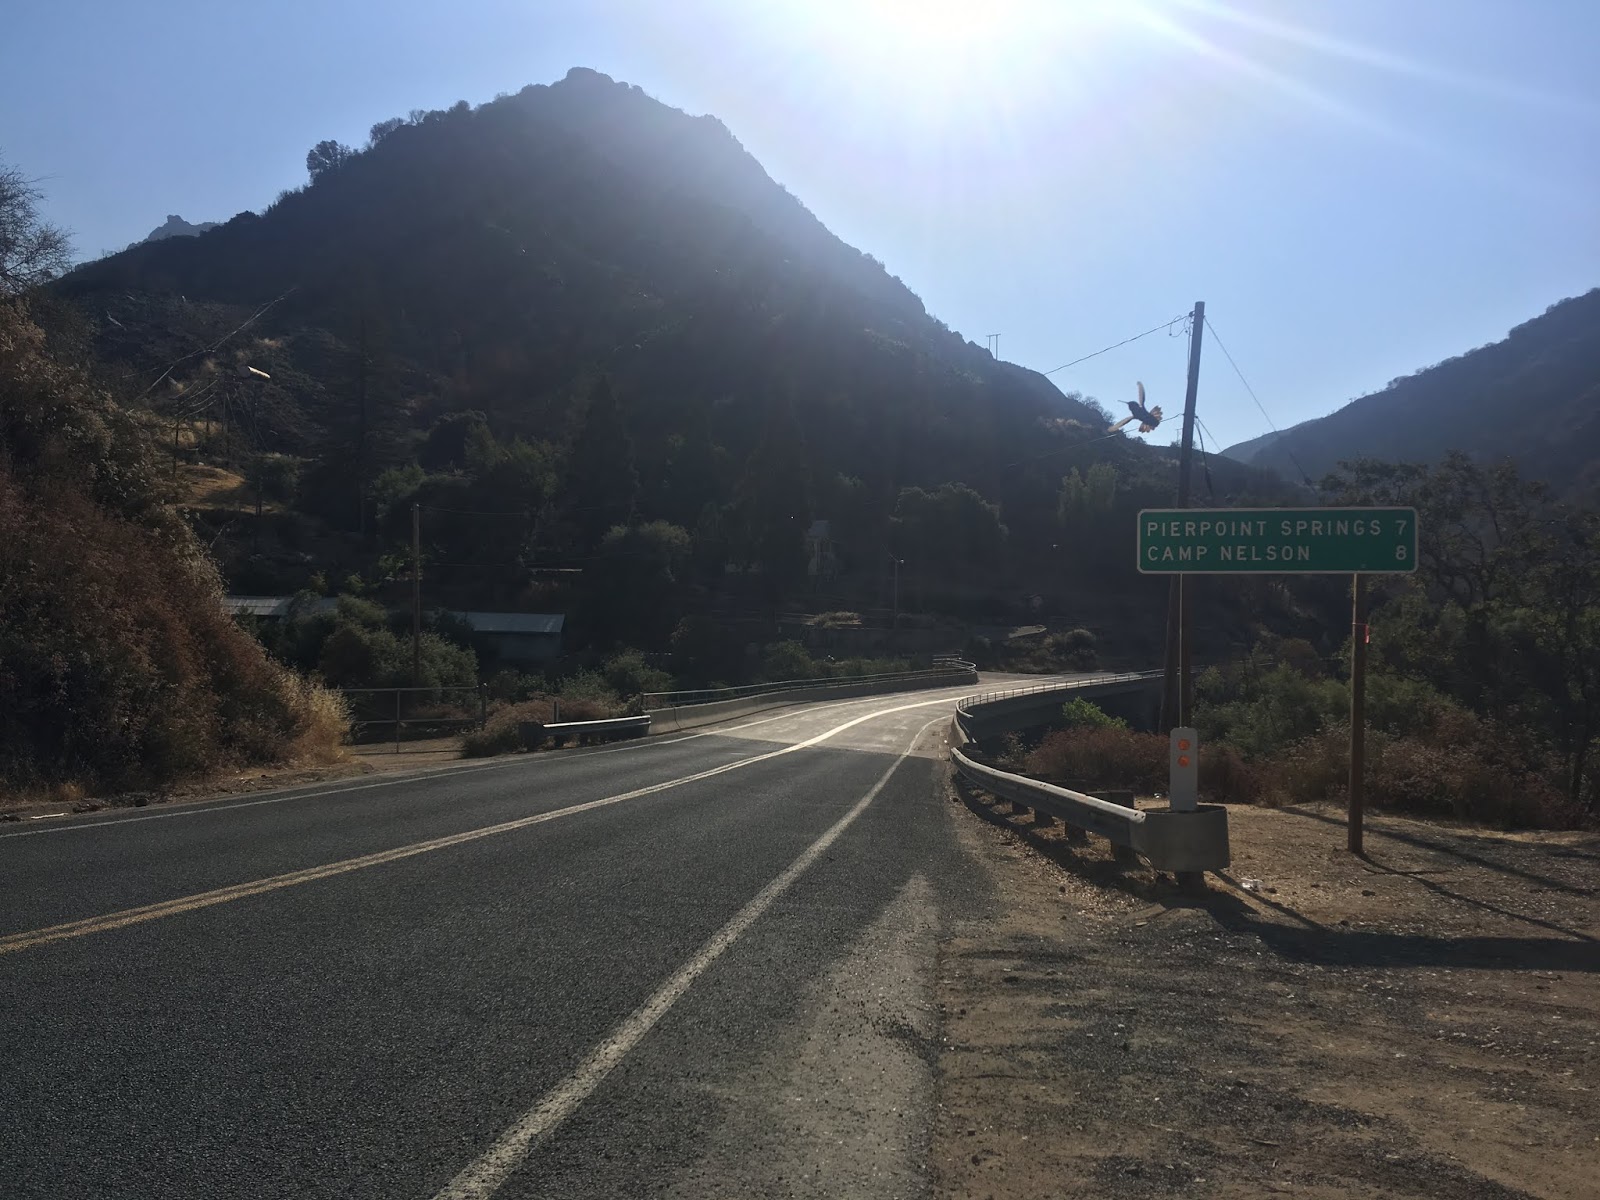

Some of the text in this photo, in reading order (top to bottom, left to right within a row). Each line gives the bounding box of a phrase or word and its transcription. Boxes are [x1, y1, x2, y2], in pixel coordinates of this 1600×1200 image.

[1146, 519, 1407, 537] PIERPOINT SPRINGS 7
[1147, 545, 1407, 561] CAMP NELSON 8
